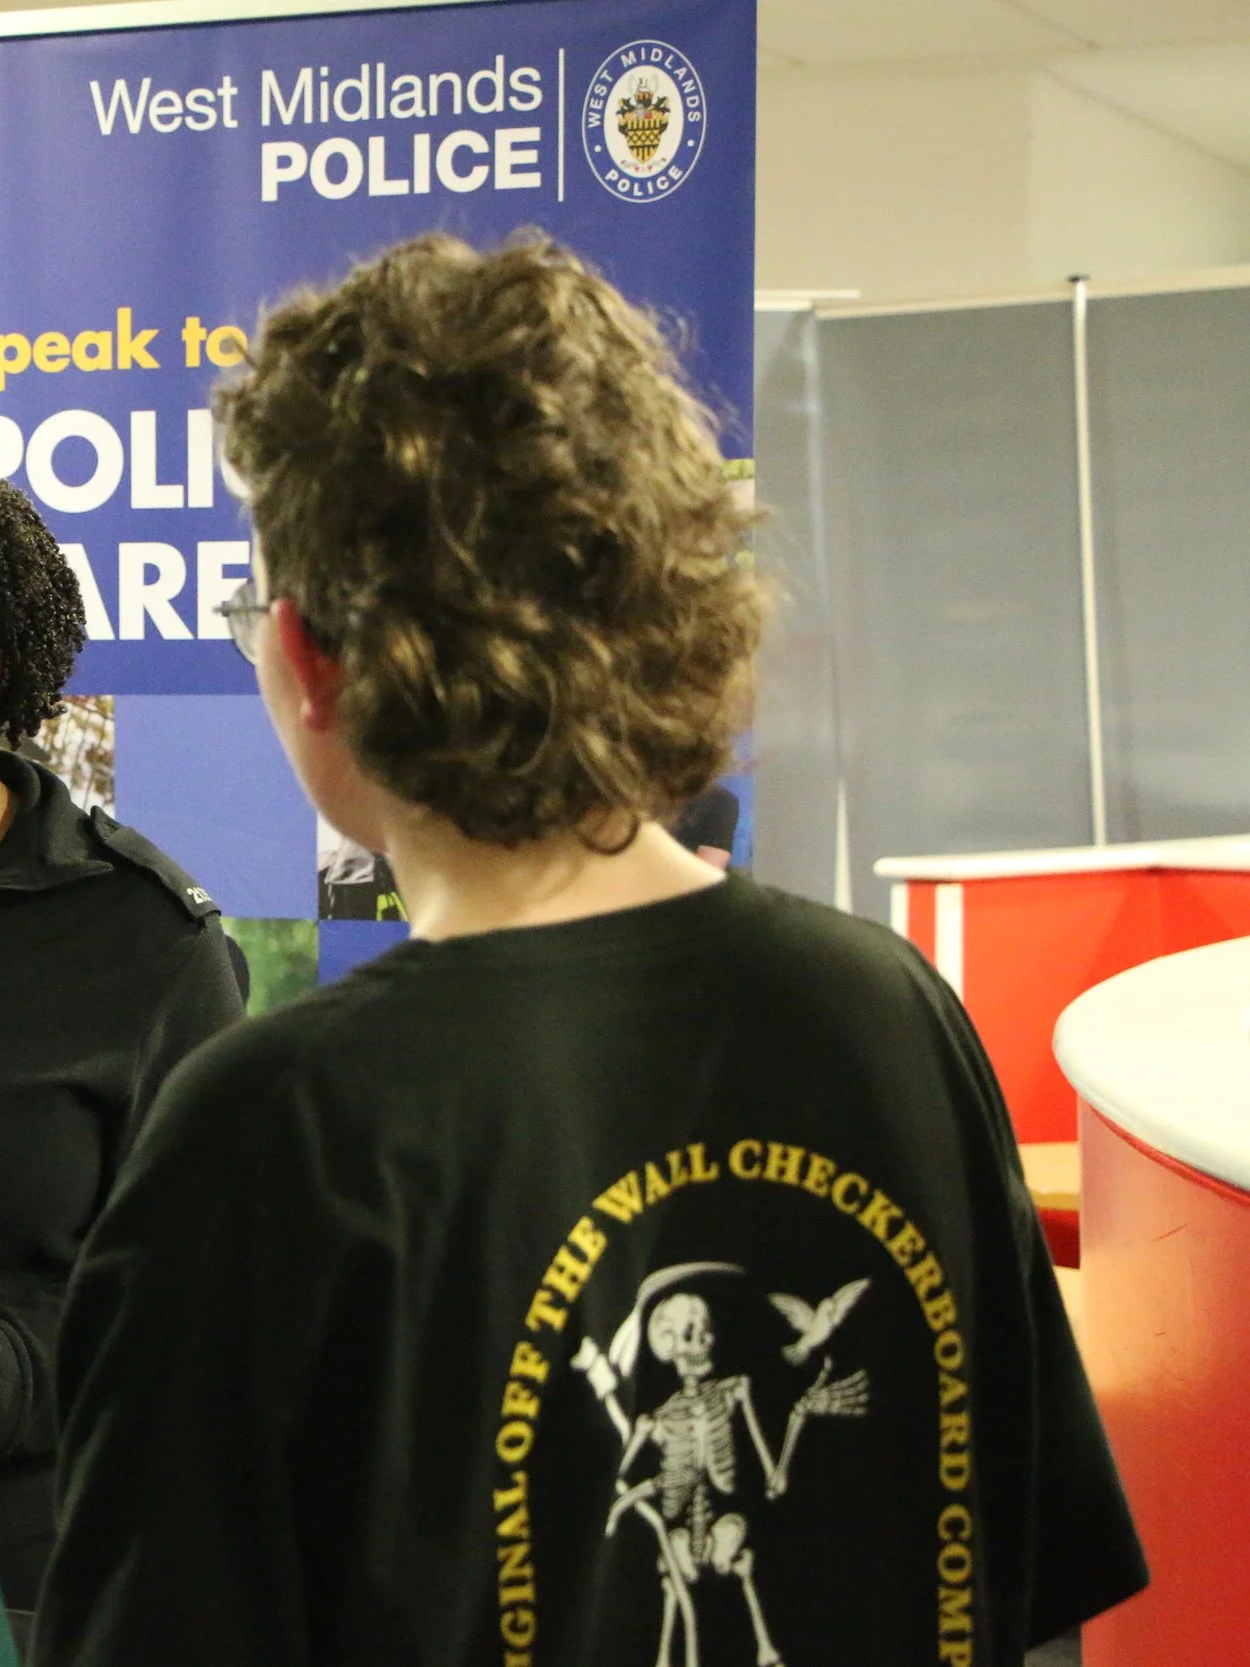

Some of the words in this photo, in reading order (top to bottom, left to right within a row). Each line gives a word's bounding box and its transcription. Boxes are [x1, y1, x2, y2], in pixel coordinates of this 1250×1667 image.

[90, 75, 238, 136] West
[261, 55, 543, 127] Midlands
[588, 69, 614, 128] WEST
[620, 47, 702, 123] MIDLANDS
[261, 127, 542, 202] POLICE
[605, 165, 683, 196] POLICE
[182, 317, 248, 367] to
[496, 1341, 550, 1463] OFF
[525, 1216, 608, 1332] THE
[592, 1143, 719, 1224] WALL
[729, 1139, 971, 1490] CHECKERBOARD
